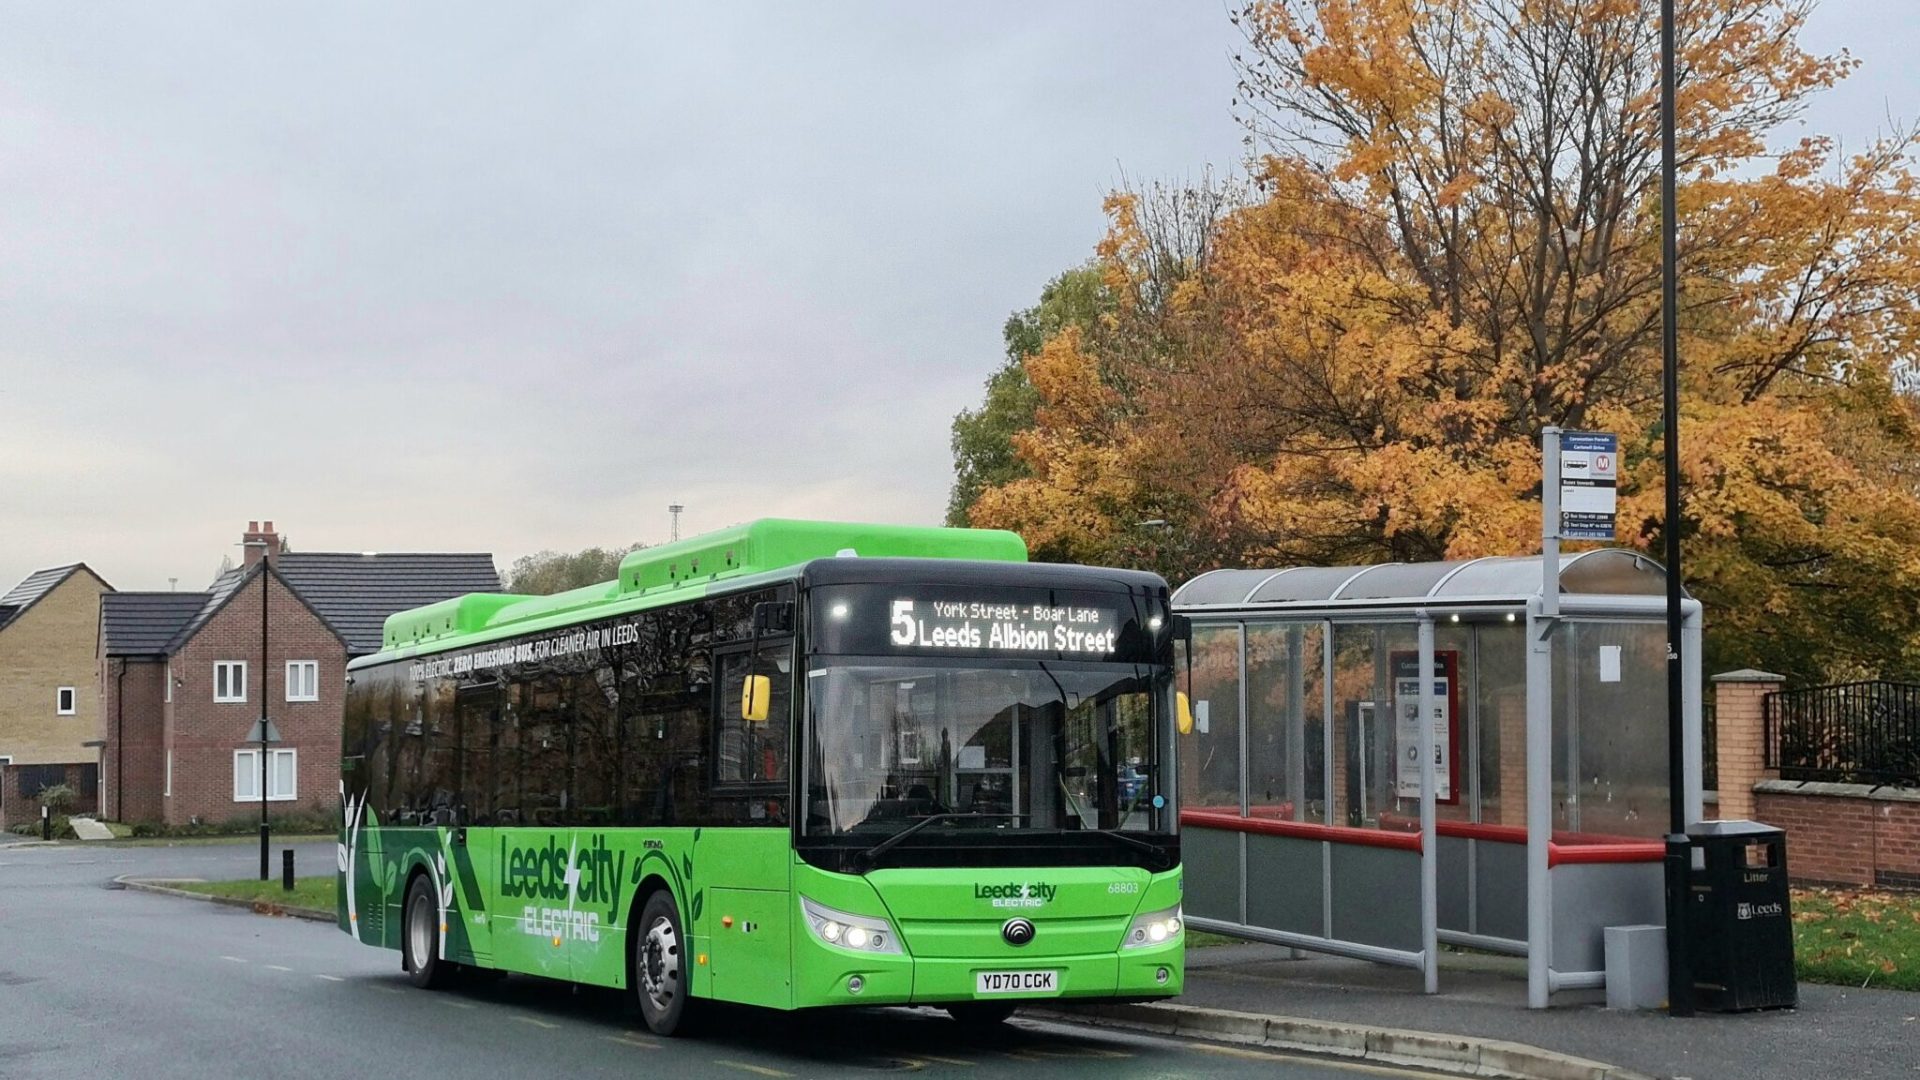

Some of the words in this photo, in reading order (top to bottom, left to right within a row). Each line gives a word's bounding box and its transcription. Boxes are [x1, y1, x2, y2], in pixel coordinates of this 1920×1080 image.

[891, 600, 917, 646] 5
[934, 602, 968, 618] York
[970, 603, 1018, 620] Street
[1033, 606, 1065, 622] Boar
[1068, 607, 1099, 624] Lane
[919, 620, 981, 648] Leeds
[988, 622, 1049, 651] Albion
[1054, 624, 1116, 653] Street
[453, 653, 473, 674] ZERO
[473, 645, 516, 670] EMISSIONS
[535, 640, 550, 659] FOR
[550, 634, 585, 656] CLEANER
[585, 631, 600, 650] AIR
[601, 628, 611, 647] IN
[612, 622, 639, 645] LEEDS
[501, 834, 569, 900] Leeds
[576, 833, 625, 924] city
[1107, 882, 1139, 894] 68803
[1743, 873, 1768, 883] Litter
[974, 882, 1022, 899] Leeds
[1028, 882, 1057, 902] city
[992, 899, 1043, 907] ELECTRIC
[1752, 902, 1782, 915] Leeds
[524, 905, 599, 942] ELECTRIC
[983, 973, 1020, 990] YD70
[1024, 972, 1052, 988] CGK
